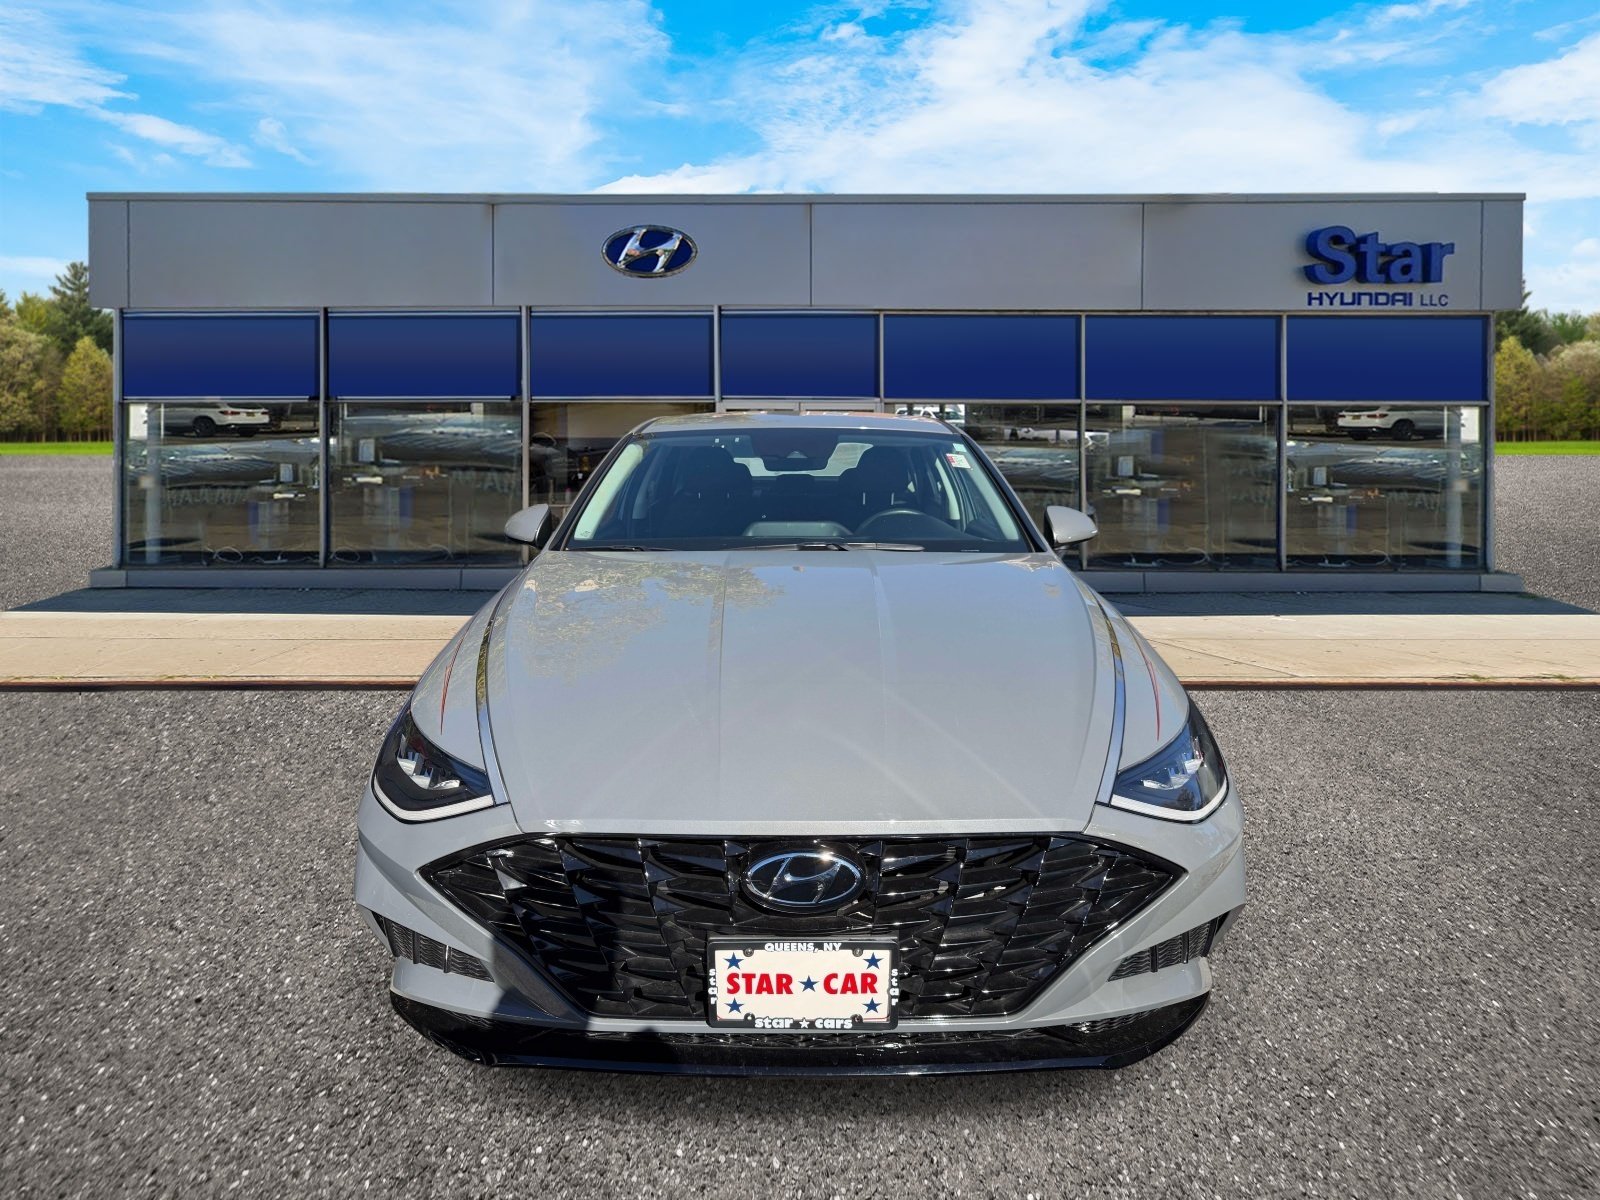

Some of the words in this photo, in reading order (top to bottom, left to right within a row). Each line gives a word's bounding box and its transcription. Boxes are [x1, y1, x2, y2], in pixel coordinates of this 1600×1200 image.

[1303, 225, 1455, 285] Star
[1307, 292, 1413, 307] HYUNDAI
[1420, 294, 1449, 307] LLC
[764, 942, 819, 953] QUEENS,
[824, 942, 842, 952] NY
[726, 972, 794, 995] STAR
[823, 972, 878, 995] CAR
[889, 968, 900, 1006] star
[754, 1016, 794, 1029] star
[814, 1017, 853, 1030] cars
